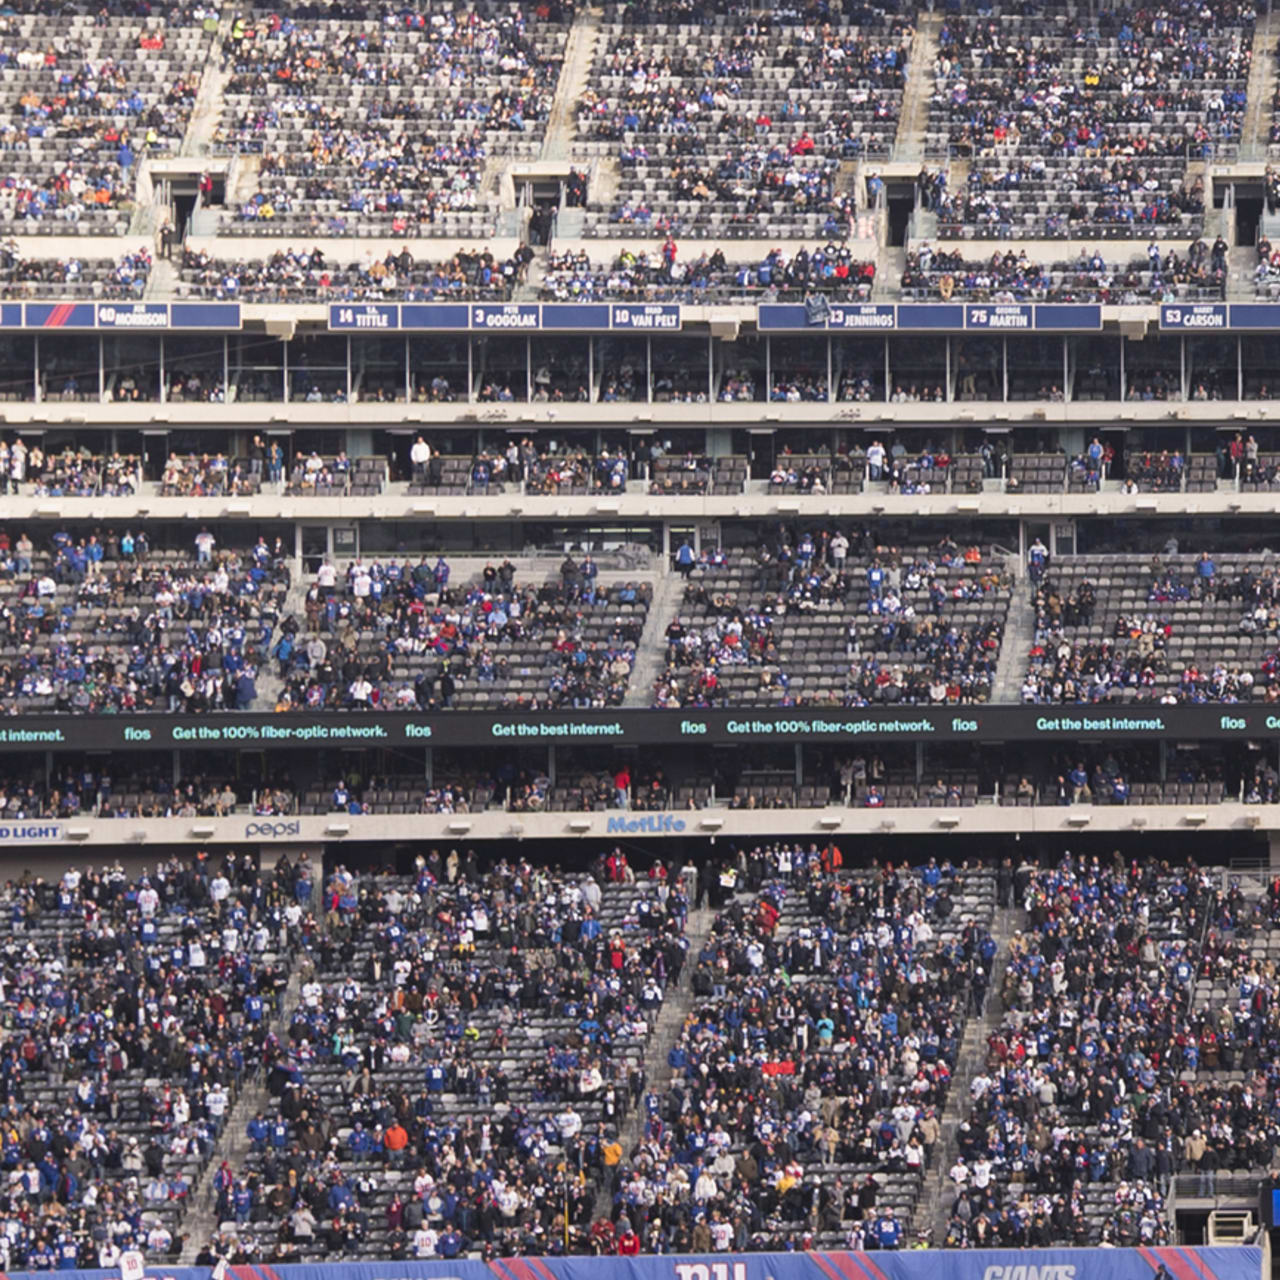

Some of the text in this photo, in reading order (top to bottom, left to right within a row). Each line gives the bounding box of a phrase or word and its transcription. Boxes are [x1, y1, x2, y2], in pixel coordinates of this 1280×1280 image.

[115, 313, 167, 325] MORRISON
[340, 309, 388, 326] 14 TITTLE
[475, 309, 537, 326] 3 GOGOLAK
[615, 310, 677, 326] 10 VAN PELT
[844, 315, 893, 326] JENNINGS
[972, 310, 987, 323] 75
[989, 315, 1028, 326] MARTIN
[1166, 310, 1181, 323] 53
[1183, 315, 1223, 326] CARSON
[172, 724, 388, 740] Get the 100% fiber-optic network.
[404, 723, 432, 738] fios
[491, 722, 625, 737] Get the best internet.
[951, 717, 978, 732] fios
[8, 728, 65, 742] internet.
[123, 726, 152, 741] fios
[245, 820, 300, 839] pepsi
[607, 814, 686, 833] MetLife
[13, 827, 59, 838] LIGHT
